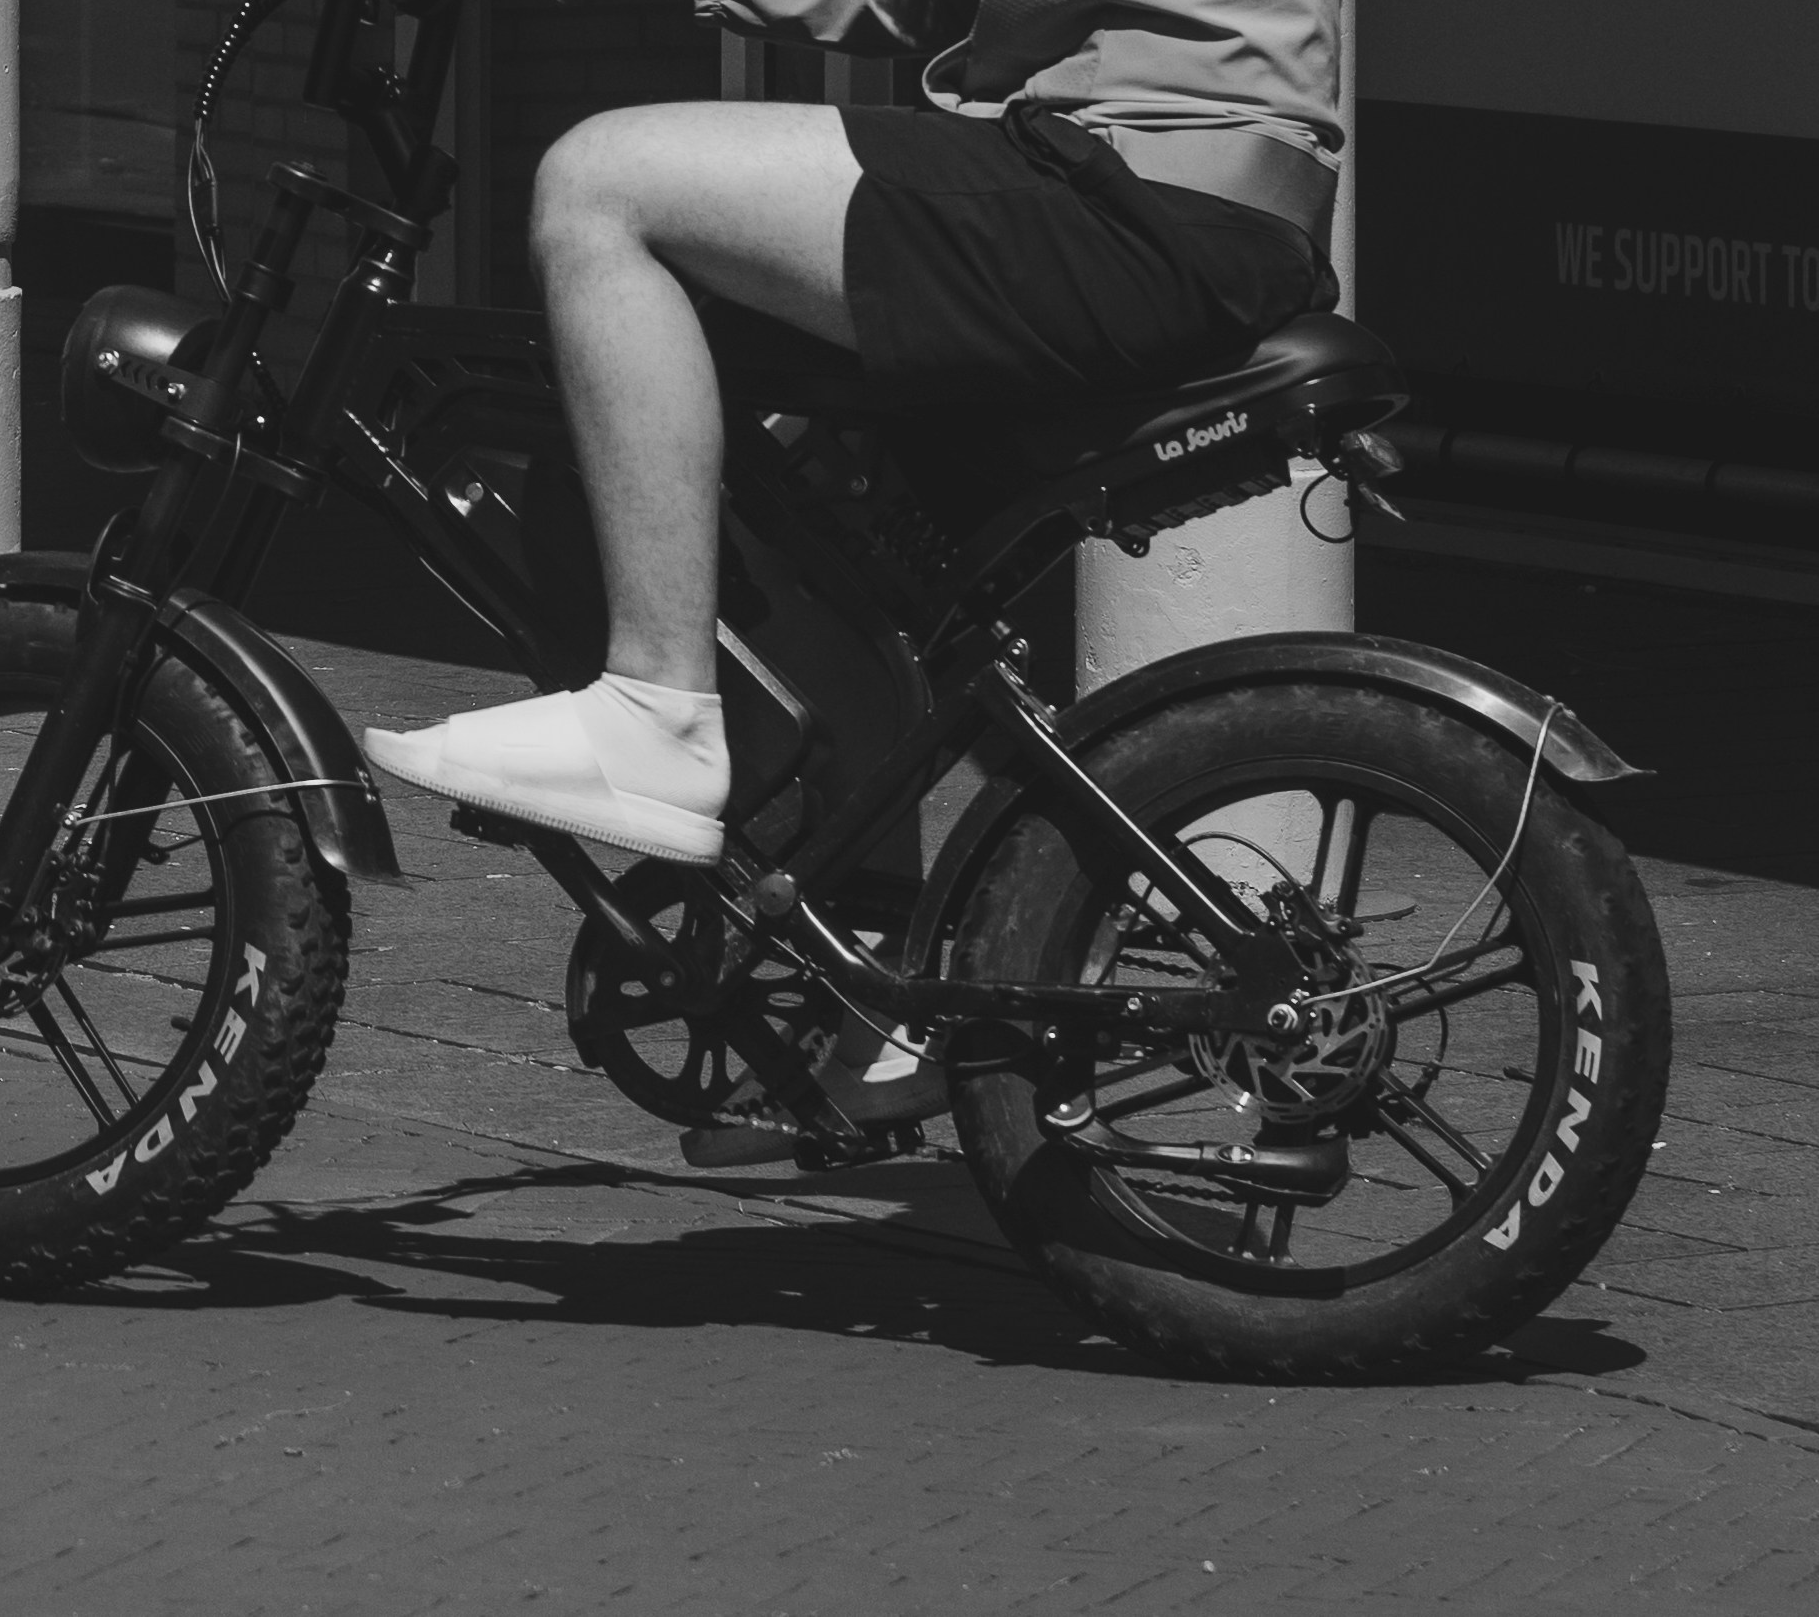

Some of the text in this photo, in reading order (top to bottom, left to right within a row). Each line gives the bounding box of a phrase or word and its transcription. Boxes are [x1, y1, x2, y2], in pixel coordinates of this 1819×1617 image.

[1556, 222, 1604, 289] WE
[1613, 228, 1772, 307] SUPPORT
[85, 942, 267, 1196] KENDA
[1483, 959, 1603, 1251] KENDA
